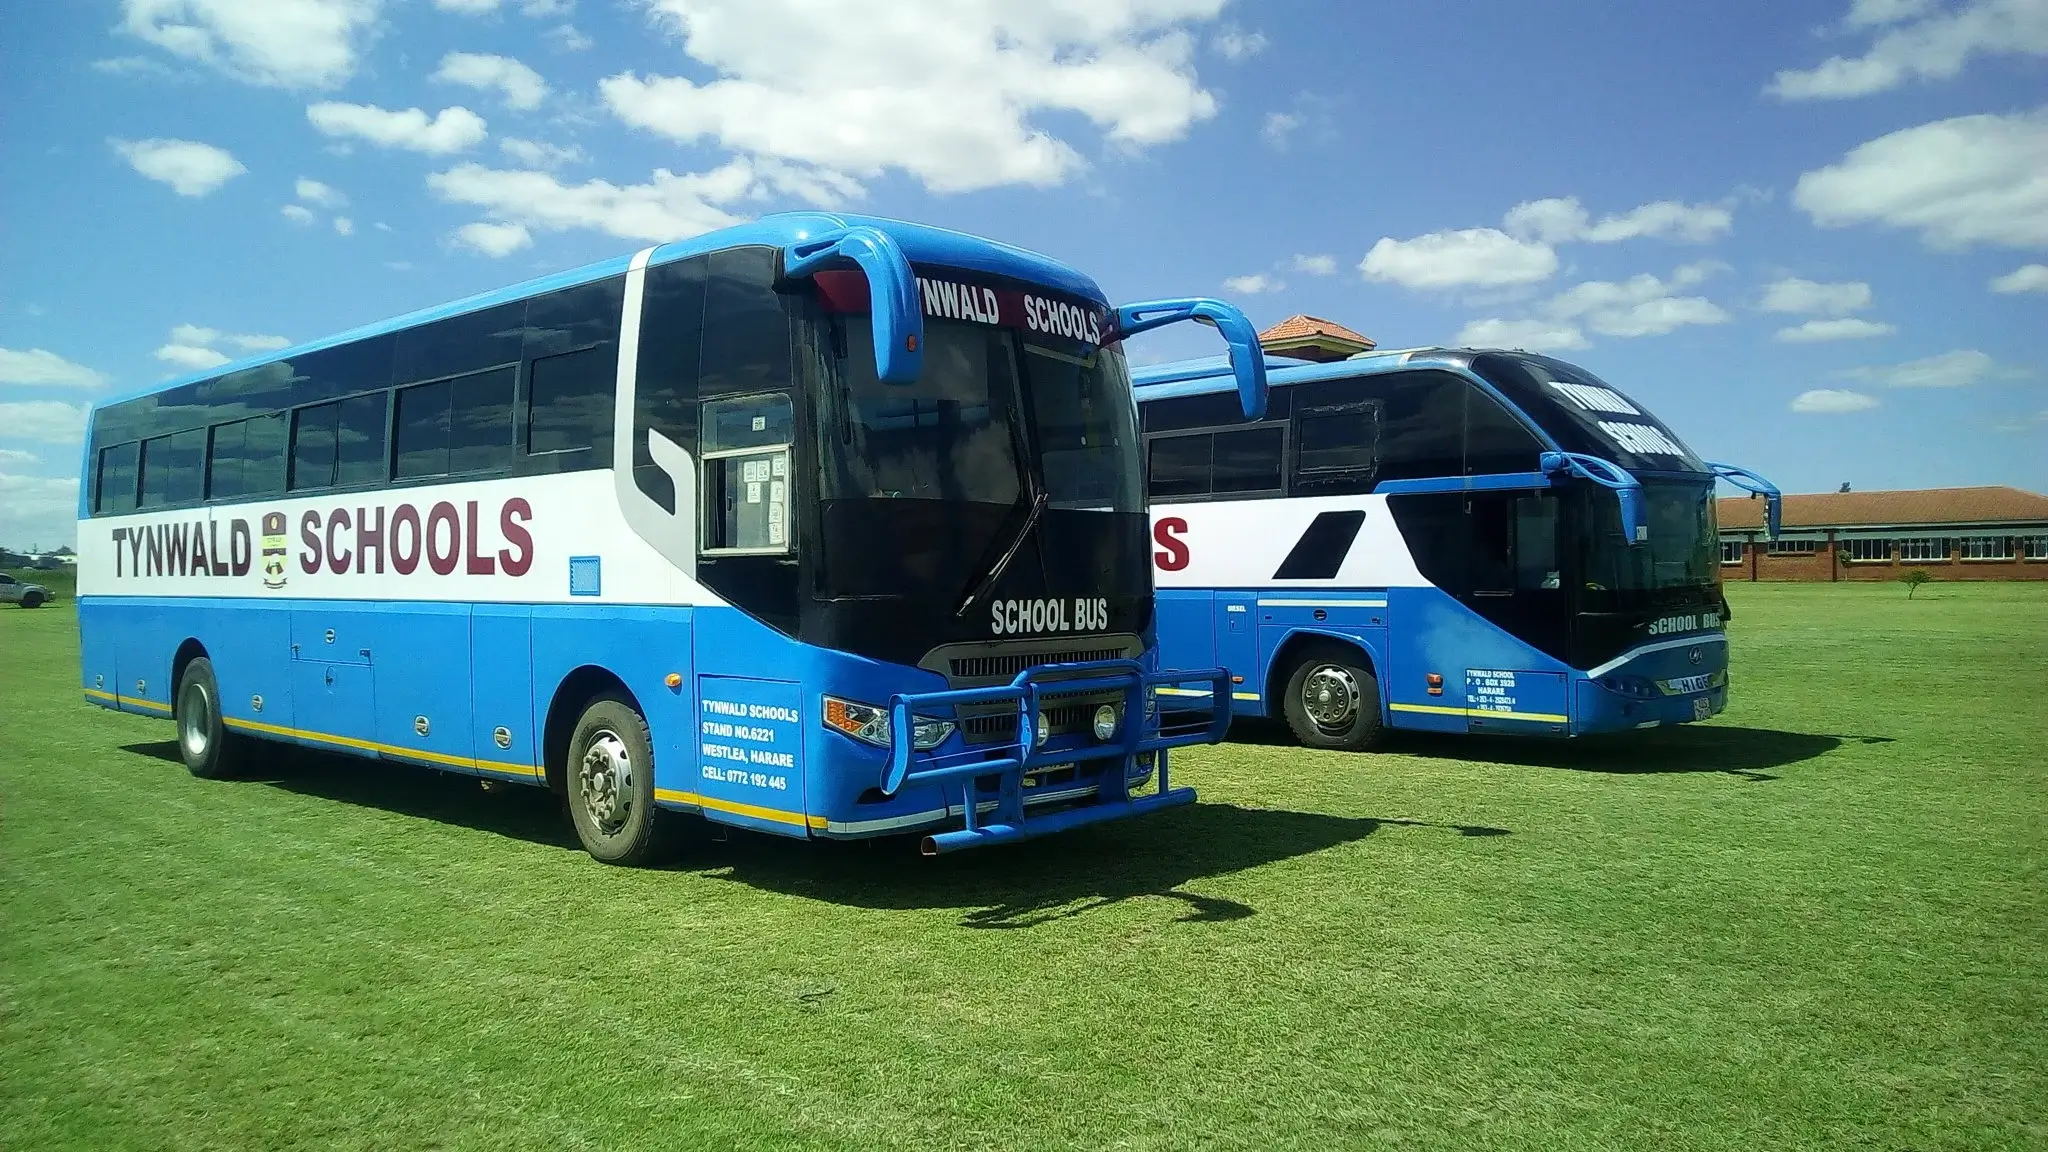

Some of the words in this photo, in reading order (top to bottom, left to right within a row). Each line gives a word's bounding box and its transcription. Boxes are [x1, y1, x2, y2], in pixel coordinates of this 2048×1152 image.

[915, 277, 1000, 325] NWALD
[1023, 294, 1101, 346] SCHOOLS
[1547, 381, 1641, 416] TYNWALD
[1597, 420, 1685, 457] SCHOOLS
[112, 518, 252, 578] TYNWALD
[299, 497, 534, 578] SCHOOLS
[991, 598, 1070, 635] SCHOOL
[1074, 597, 1108, 631] BUS
[1648, 614, 1698, 635] SCHOOL
[1702, 612, 1721, 629] BUS
[1466, 669, 1491, 677] TYNWALD
[1493, 671, 1514, 679] SCHOOL
[1485, 678, 1498, 686] BOX
[1478, 687, 1505, 695] HARARE
[702, 700, 747, 717] TYNWALD
[749, 704, 799, 723] SCHOOLS
[702, 722, 733, 737] STAND
[734, 725, 775, 743] NO.6221
[702, 743, 749, 764] WESTLEA,
[750, 749, 794, 768] HARARE
[702, 765, 726, 781] CELL:
[727, 769, 748, 785] 0772
[750, 772, 767, 788] 192
[768, 775, 787, 791] 445
